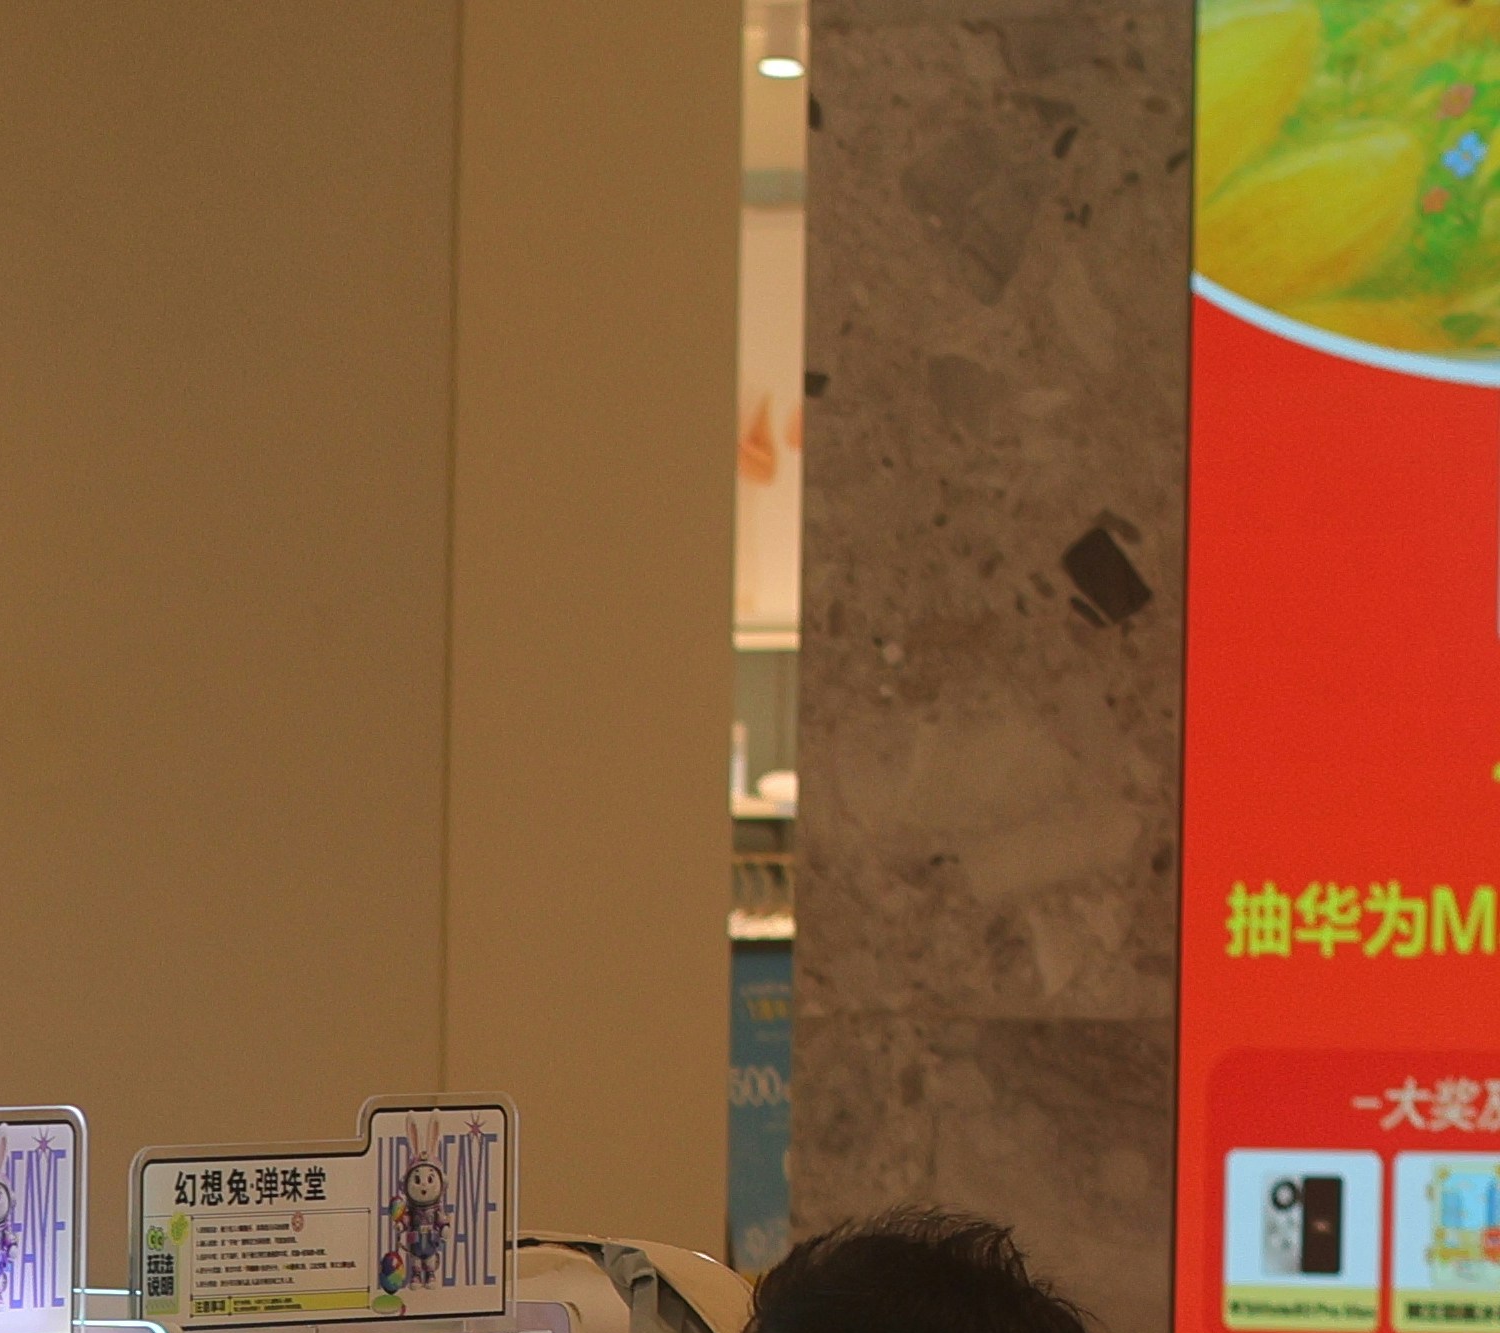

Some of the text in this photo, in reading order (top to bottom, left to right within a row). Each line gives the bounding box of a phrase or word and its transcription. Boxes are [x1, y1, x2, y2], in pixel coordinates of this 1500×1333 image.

[175, 1164, 327, 1208] 幻想兔·弹珠堂
[146, 1252, 176, 1275] 玩法
[146, 1275, 176, 1298] 说明
